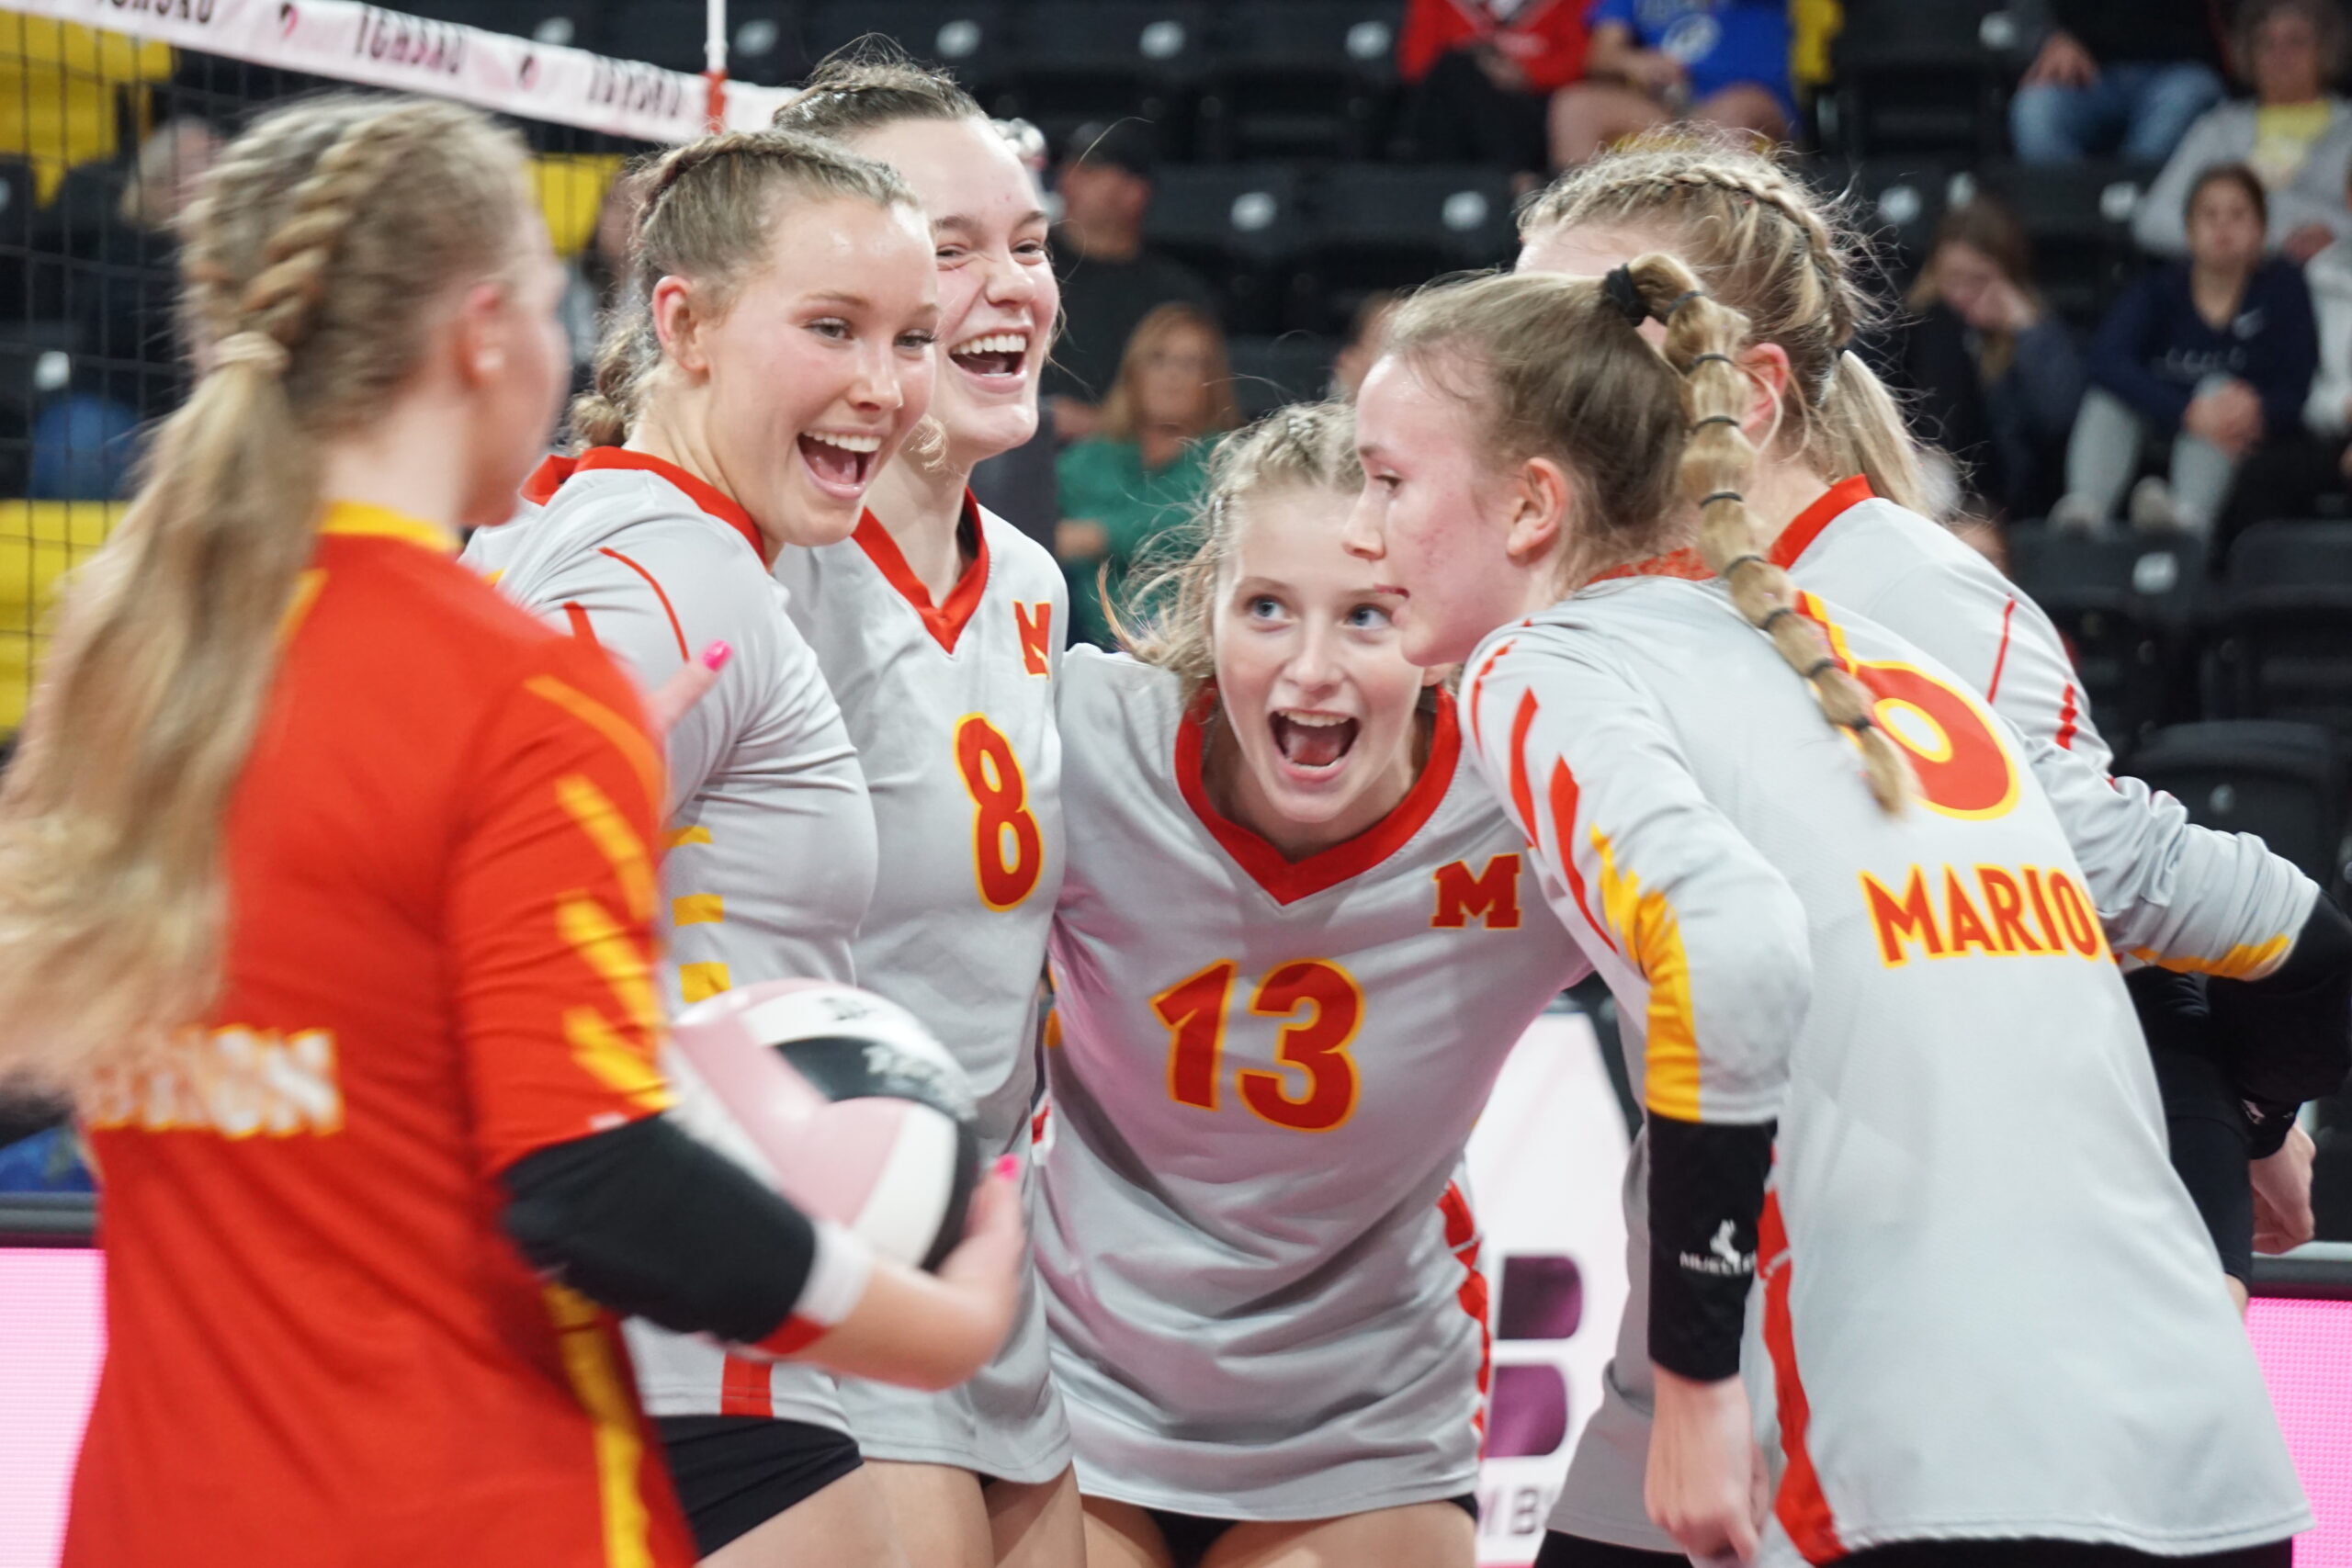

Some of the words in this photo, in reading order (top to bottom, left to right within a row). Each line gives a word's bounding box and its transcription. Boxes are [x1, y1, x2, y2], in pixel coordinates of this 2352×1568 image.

[953, 711, 1045, 913] 8
[1430, 852, 1521, 931] M
[1857, 863, 2119, 969] MARIO
[1148, 956, 1366, 1134] 13
